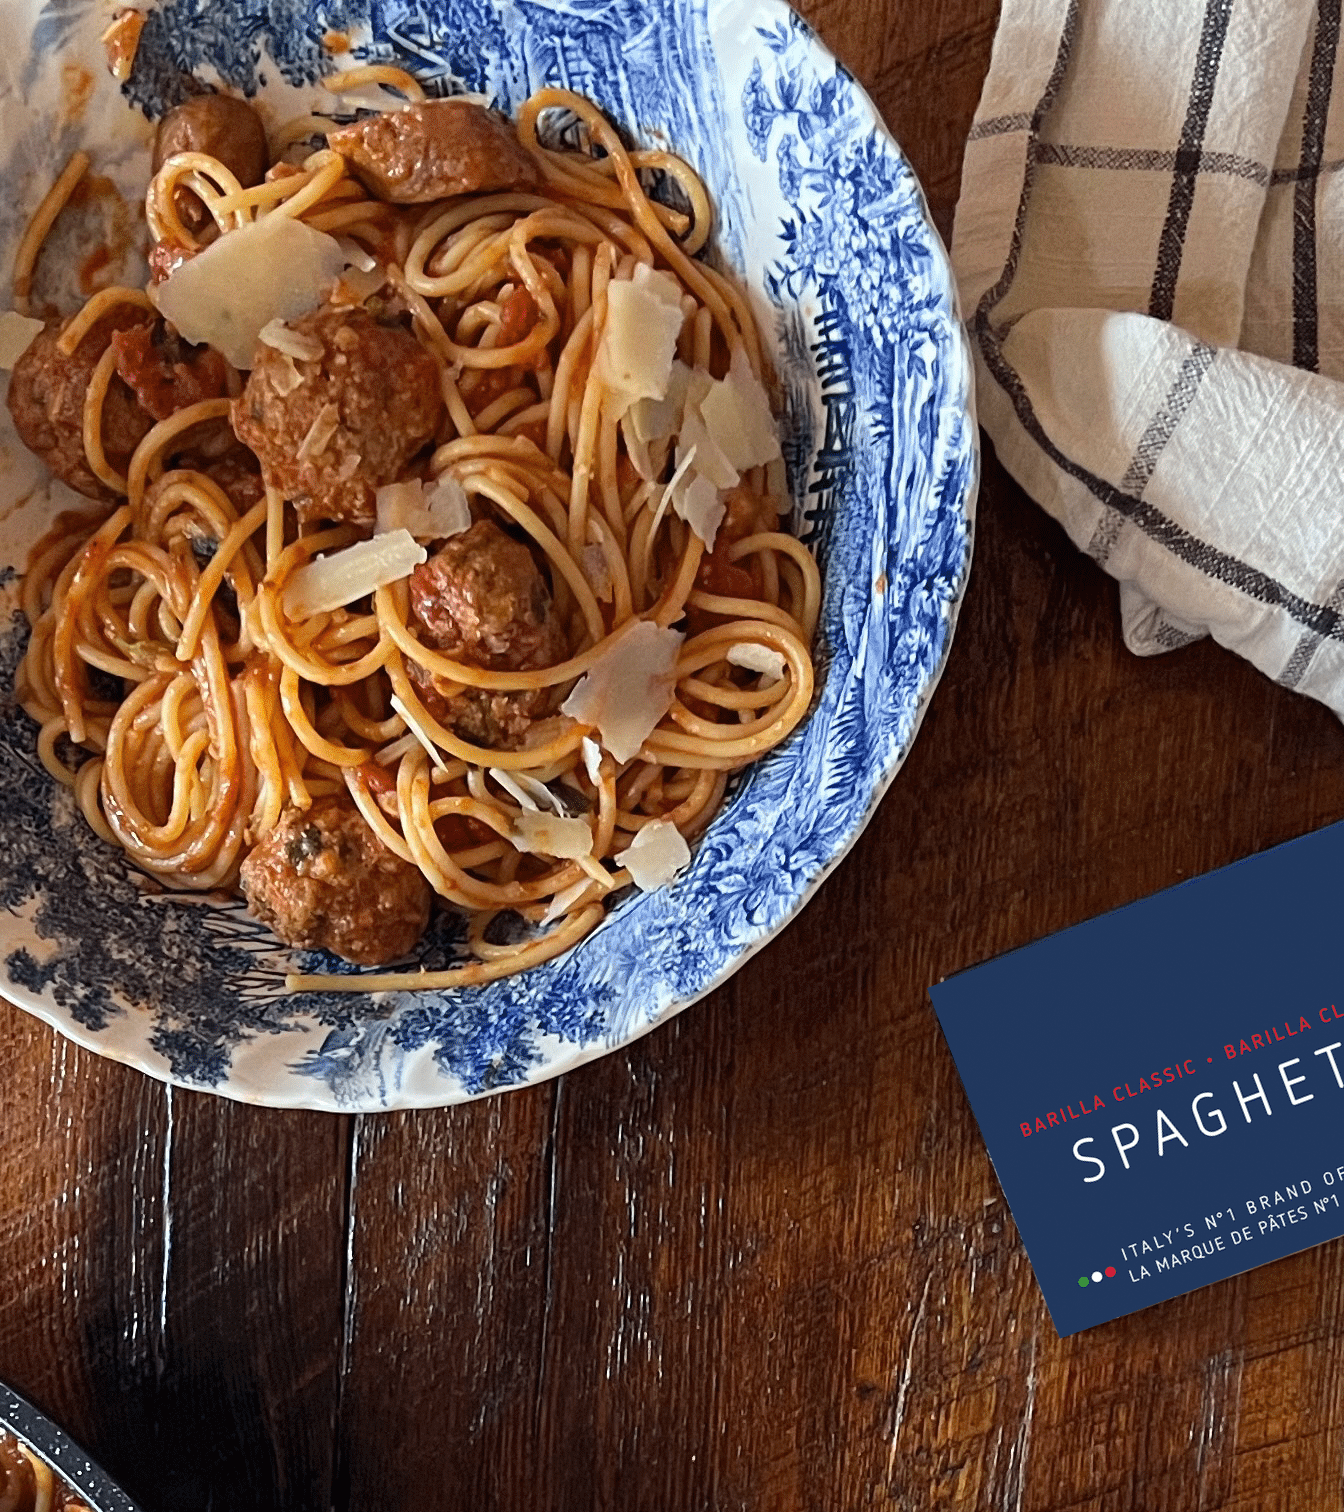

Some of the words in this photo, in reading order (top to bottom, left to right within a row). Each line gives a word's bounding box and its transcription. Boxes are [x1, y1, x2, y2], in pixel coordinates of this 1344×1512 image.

[1019, 1094, 1106, 1138] BARILLA
[1112, 1059, 1196, 1102] CLASSIC
[1223, 1016, 1312, 1060] BARILLA
[1245, 1180, 1312, 1215] BRAND
[1128, 1265, 1151, 1283] LA
[1155, 1236, 1226, 1273] MARQUE
[1230, 1226, 1254, 1245] DE
[1258, 1205, 1308, 1235] PÂTES
